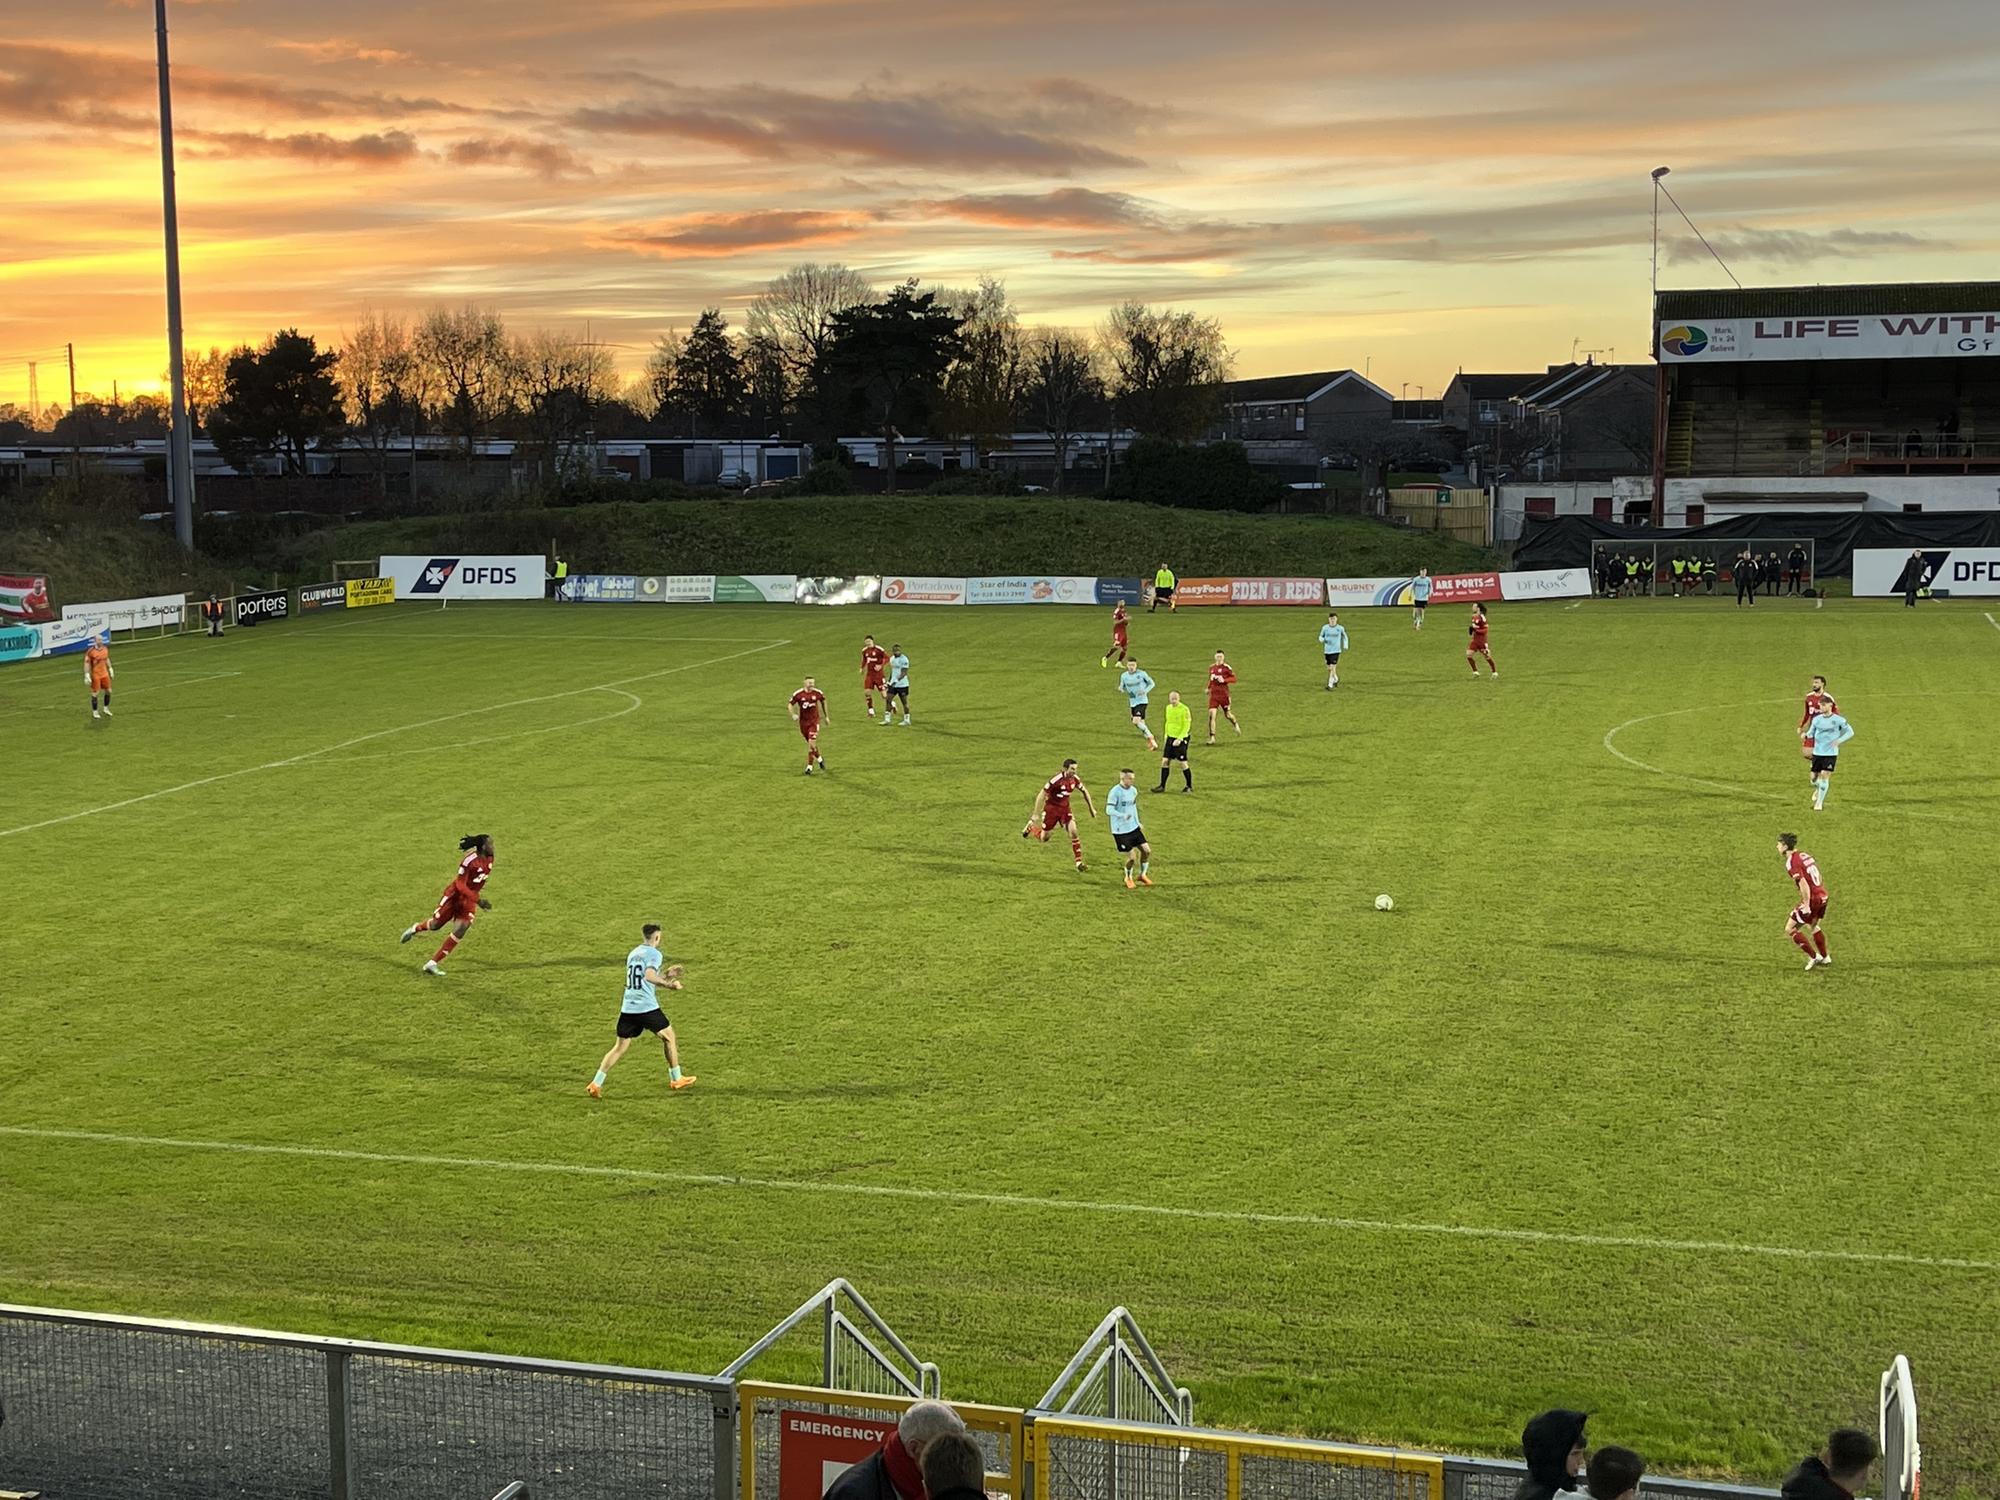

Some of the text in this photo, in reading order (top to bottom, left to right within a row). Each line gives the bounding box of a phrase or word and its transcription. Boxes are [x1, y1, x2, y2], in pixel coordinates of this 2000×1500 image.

[1755, 319, 1859, 338] LIFE
[463, 567, 516, 584] DFDS
[1436, 578, 1484, 590] ARE PORTS
[907, 580, 962, 592] Portadown
[980, 580, 1027, 589] Star of India
[1180, 584, 1228, 594] easyFood
[1232, 582, 1322, 600] EDEN REDS
[238, 596, 287, 619] porters
[791, 1419, 885, 1443] EMERGENCY
